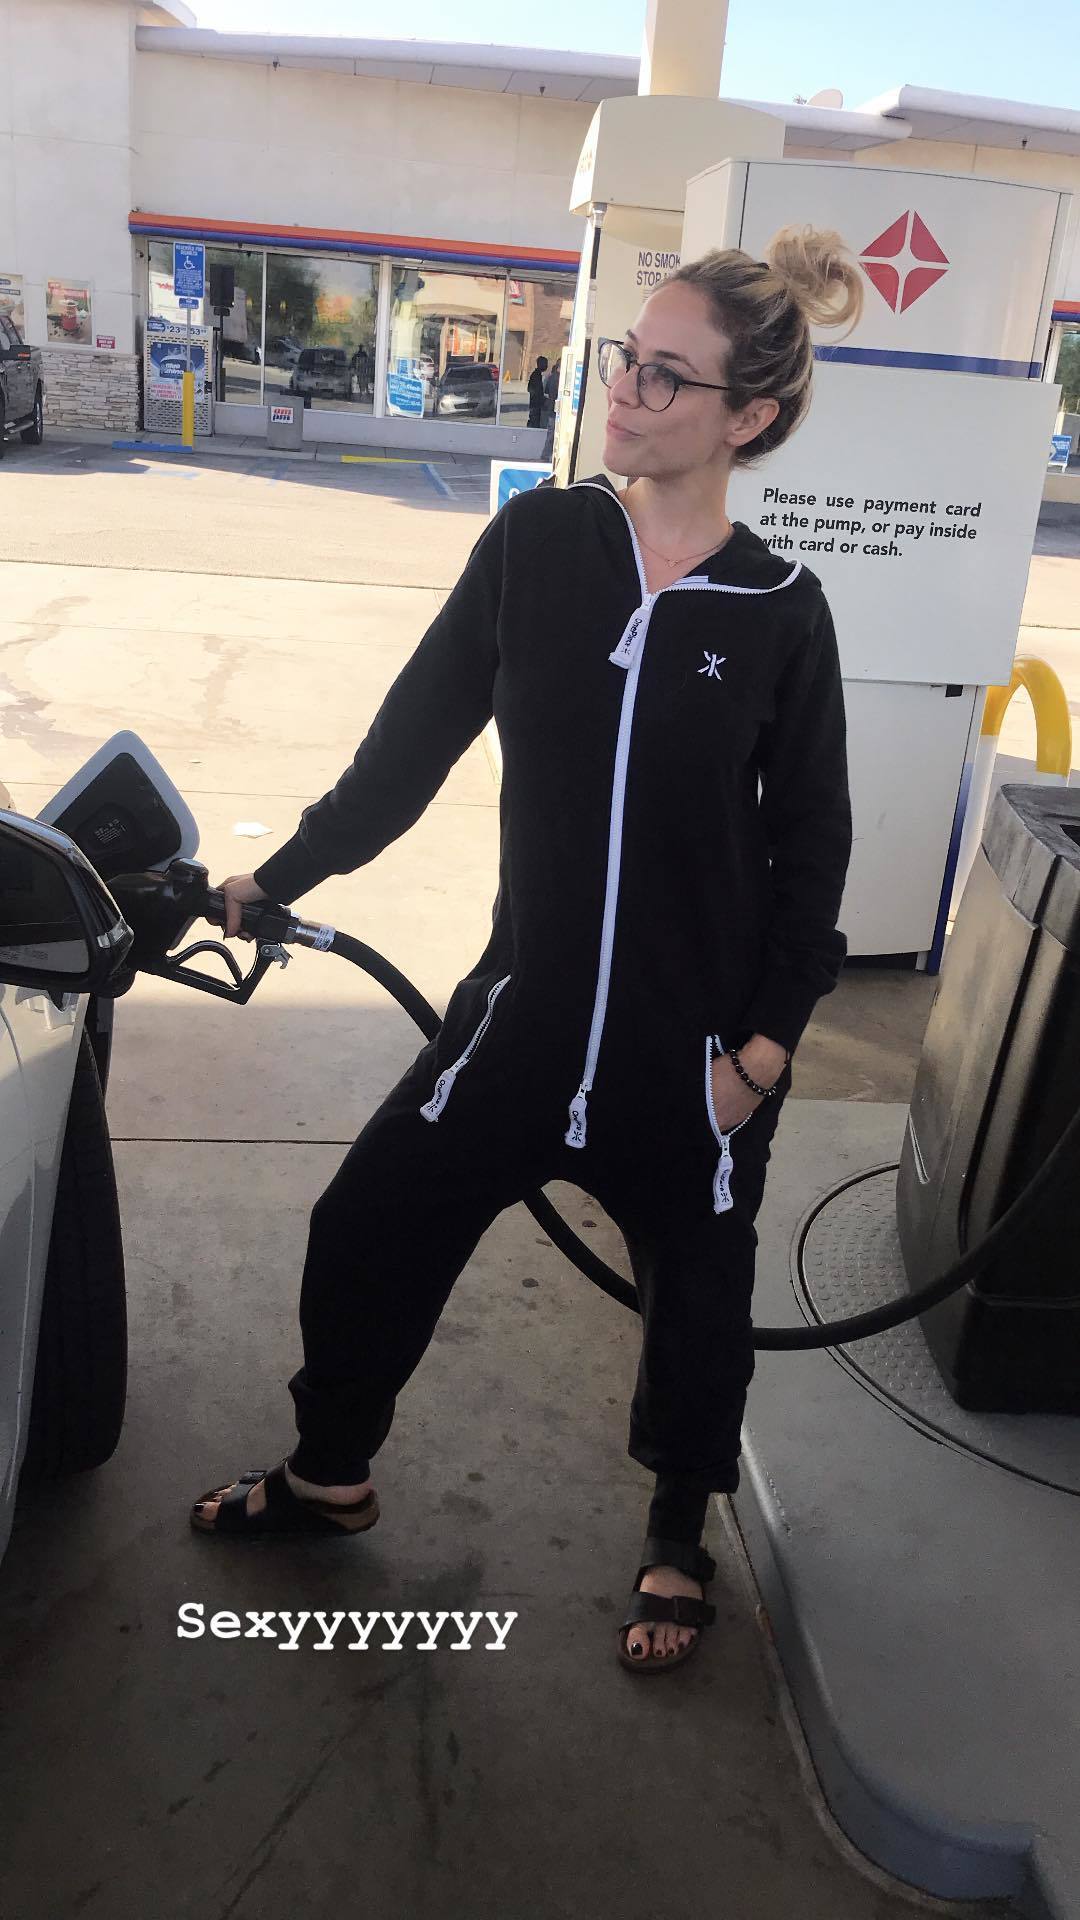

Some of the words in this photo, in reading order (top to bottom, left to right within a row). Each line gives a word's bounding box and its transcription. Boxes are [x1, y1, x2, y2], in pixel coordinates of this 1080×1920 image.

[638, 251, 653, 267] NO
[636, 270, 662, 287] STOP
[763, 488, 817, 505] Please
[826, 496, 855, 508] use
[863, 499, 937, 515] payment
[945, 502, 982, 517] card
[760, 513, 777, 526] at
[781, 511, 809, 528] the
[813, 518, 866, 535] pump,
[871, 522, 891, 533] or
[894, 524, 925, 539] pay
[929, 522, 977, 539] inside
[799, 537, 835, 552] card
[839, 543, 858, 553] or
[862, 541, 903, 556] cash.
